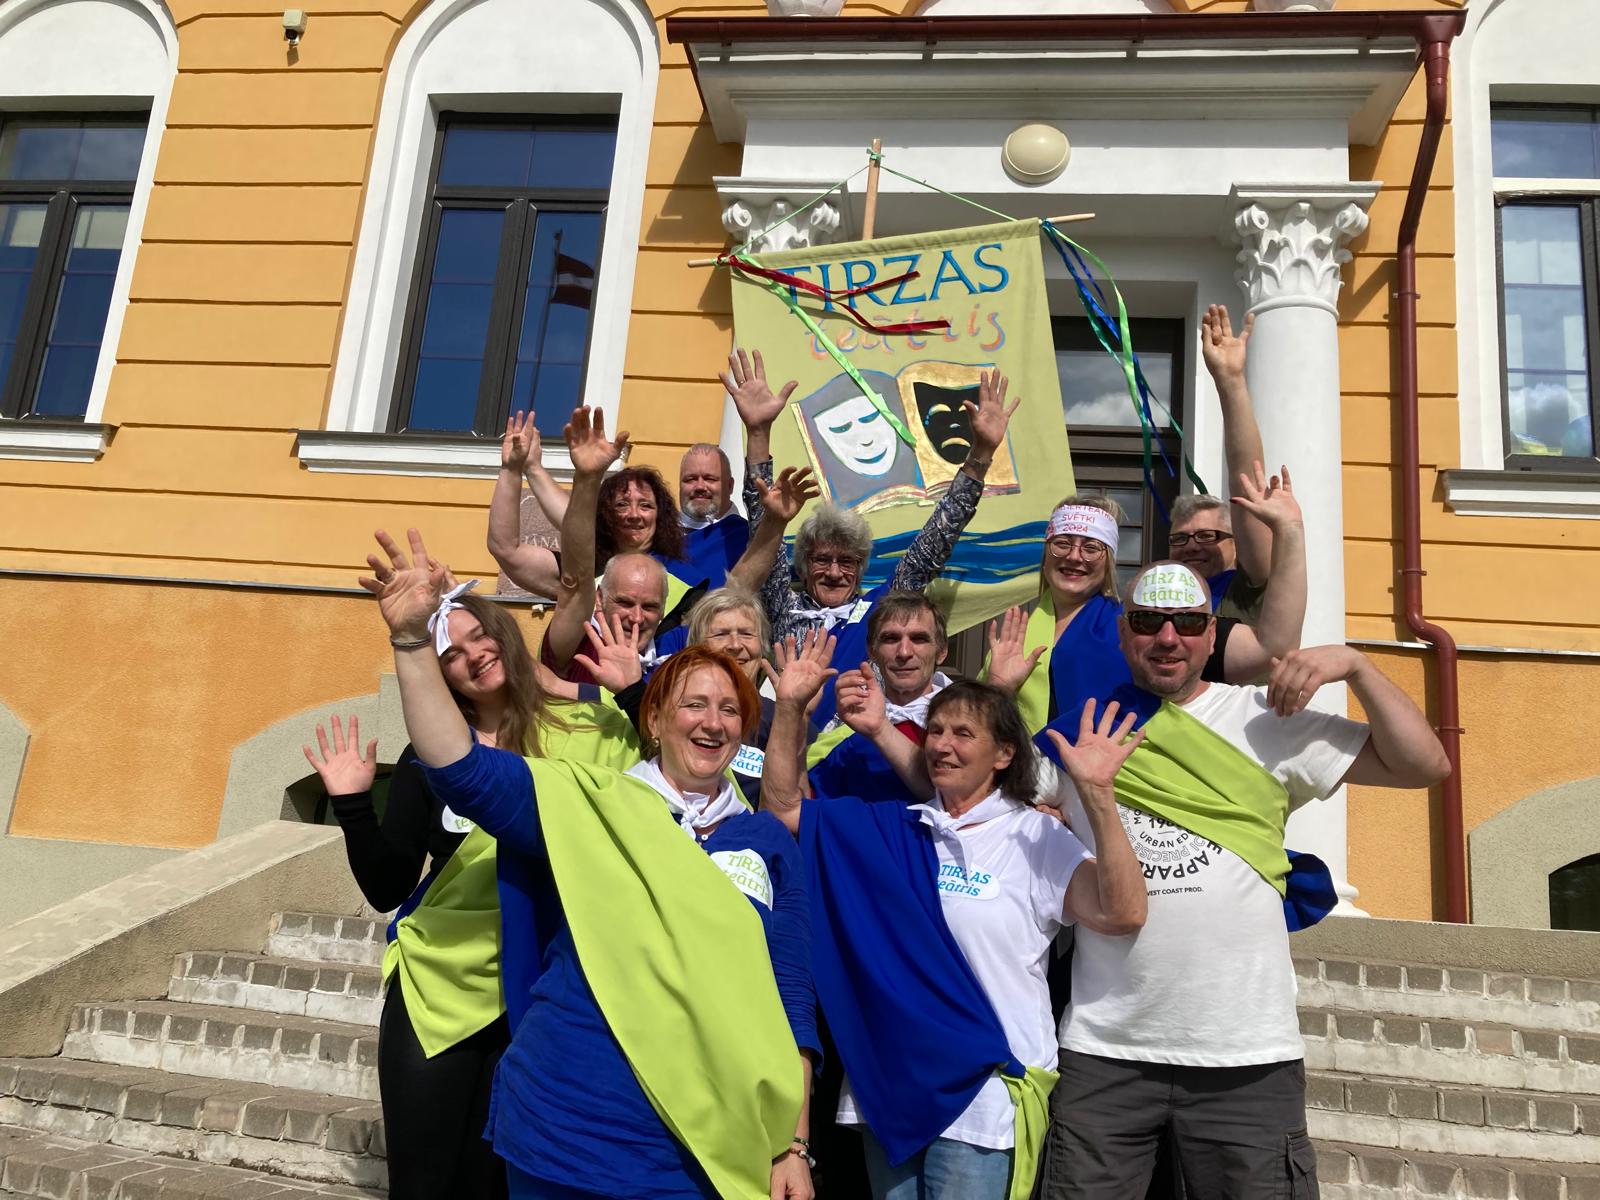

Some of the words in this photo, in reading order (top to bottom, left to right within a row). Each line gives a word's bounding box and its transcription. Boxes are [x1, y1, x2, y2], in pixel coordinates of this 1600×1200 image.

[777, 243, 1009, 314] TIRZAS
[1142, 572, 1196, 588] TIRZAS
[739, 748, 765, 762] RZA
[1139, 831, 1175, 848] URBAN
[1138, 850, 1210, 881] APPAR
[1161, 887, 1184, 896] COAST
